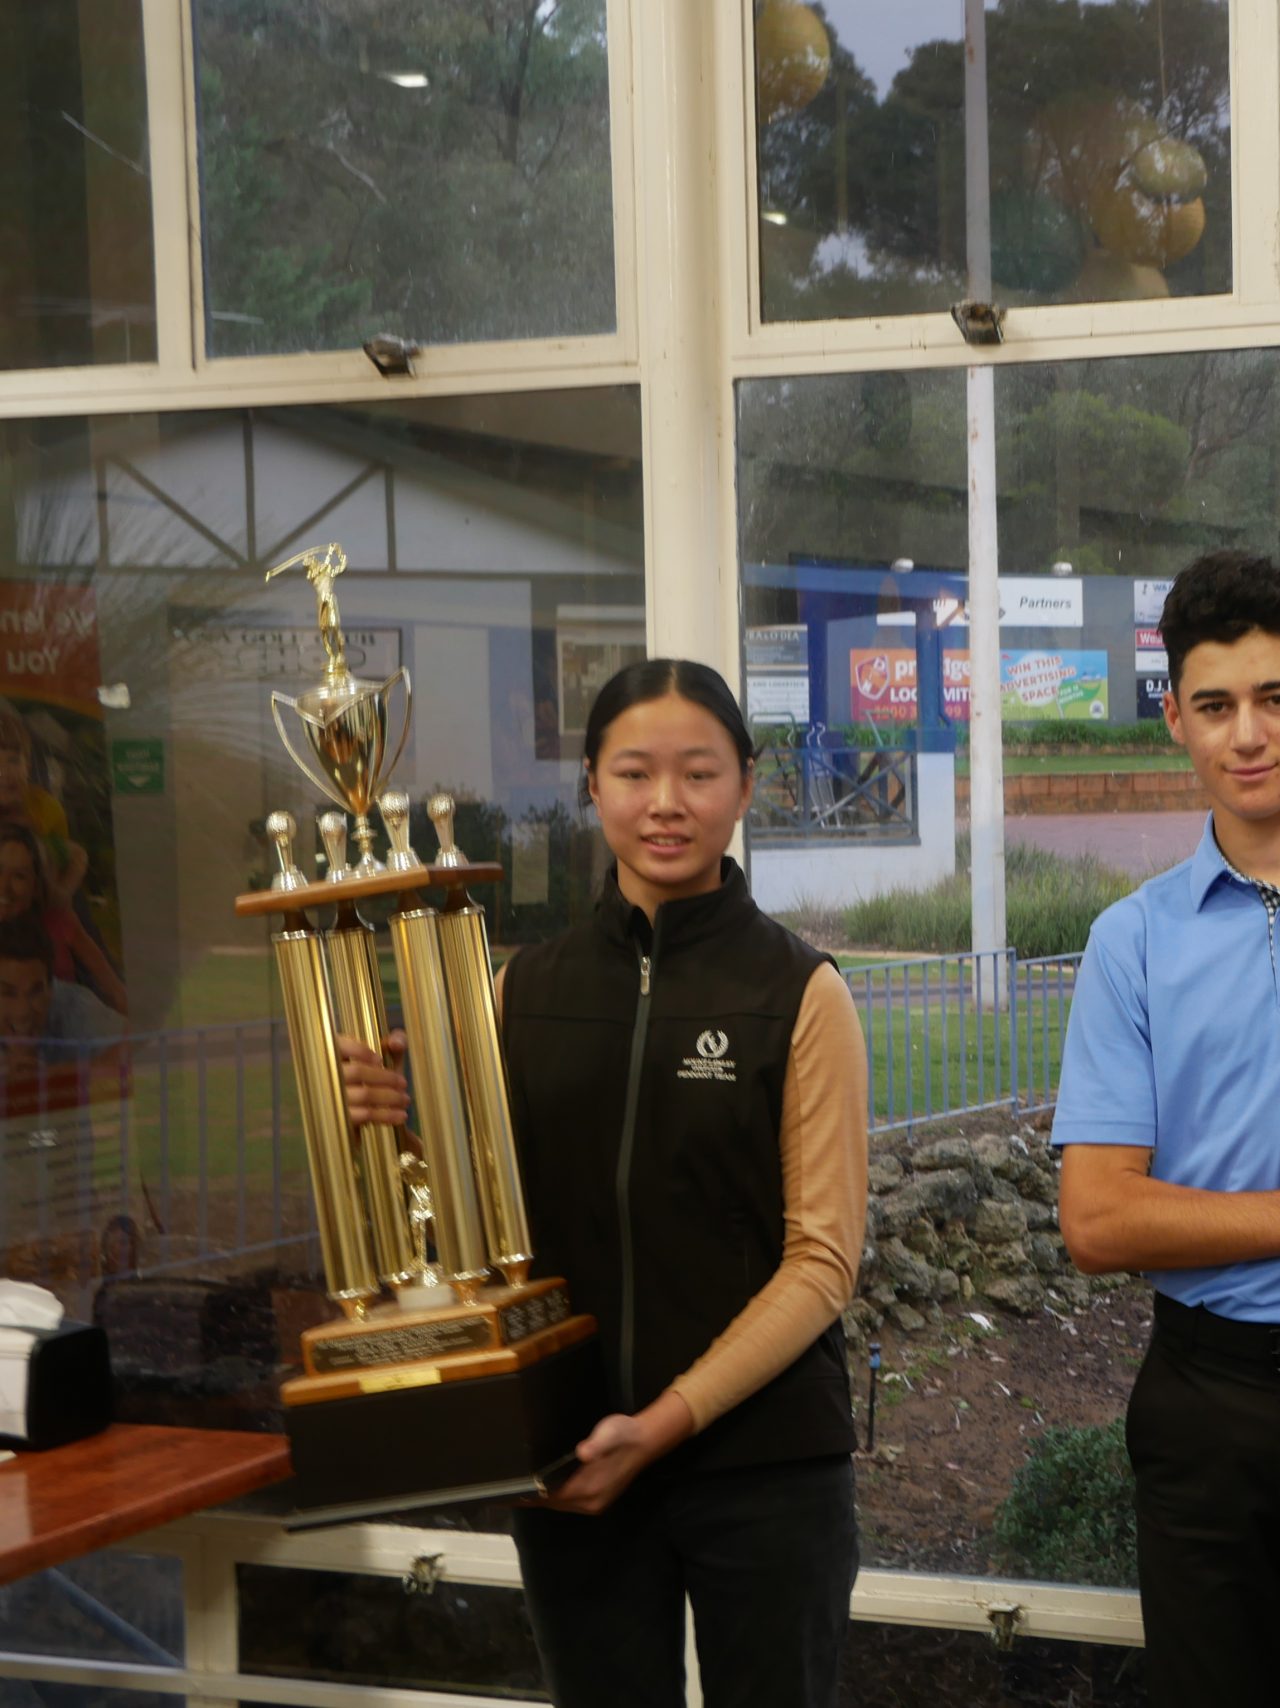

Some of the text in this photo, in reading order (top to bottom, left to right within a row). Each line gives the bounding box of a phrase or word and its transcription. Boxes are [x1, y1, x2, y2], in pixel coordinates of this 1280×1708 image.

[1019, 596, 1072, 609] Partners
[1008, 655, 1063, 676] WIN THIS
[1000, 666, 1076, 692] ADVERTISING
[1022, 684, 1057, 701] SPACE
